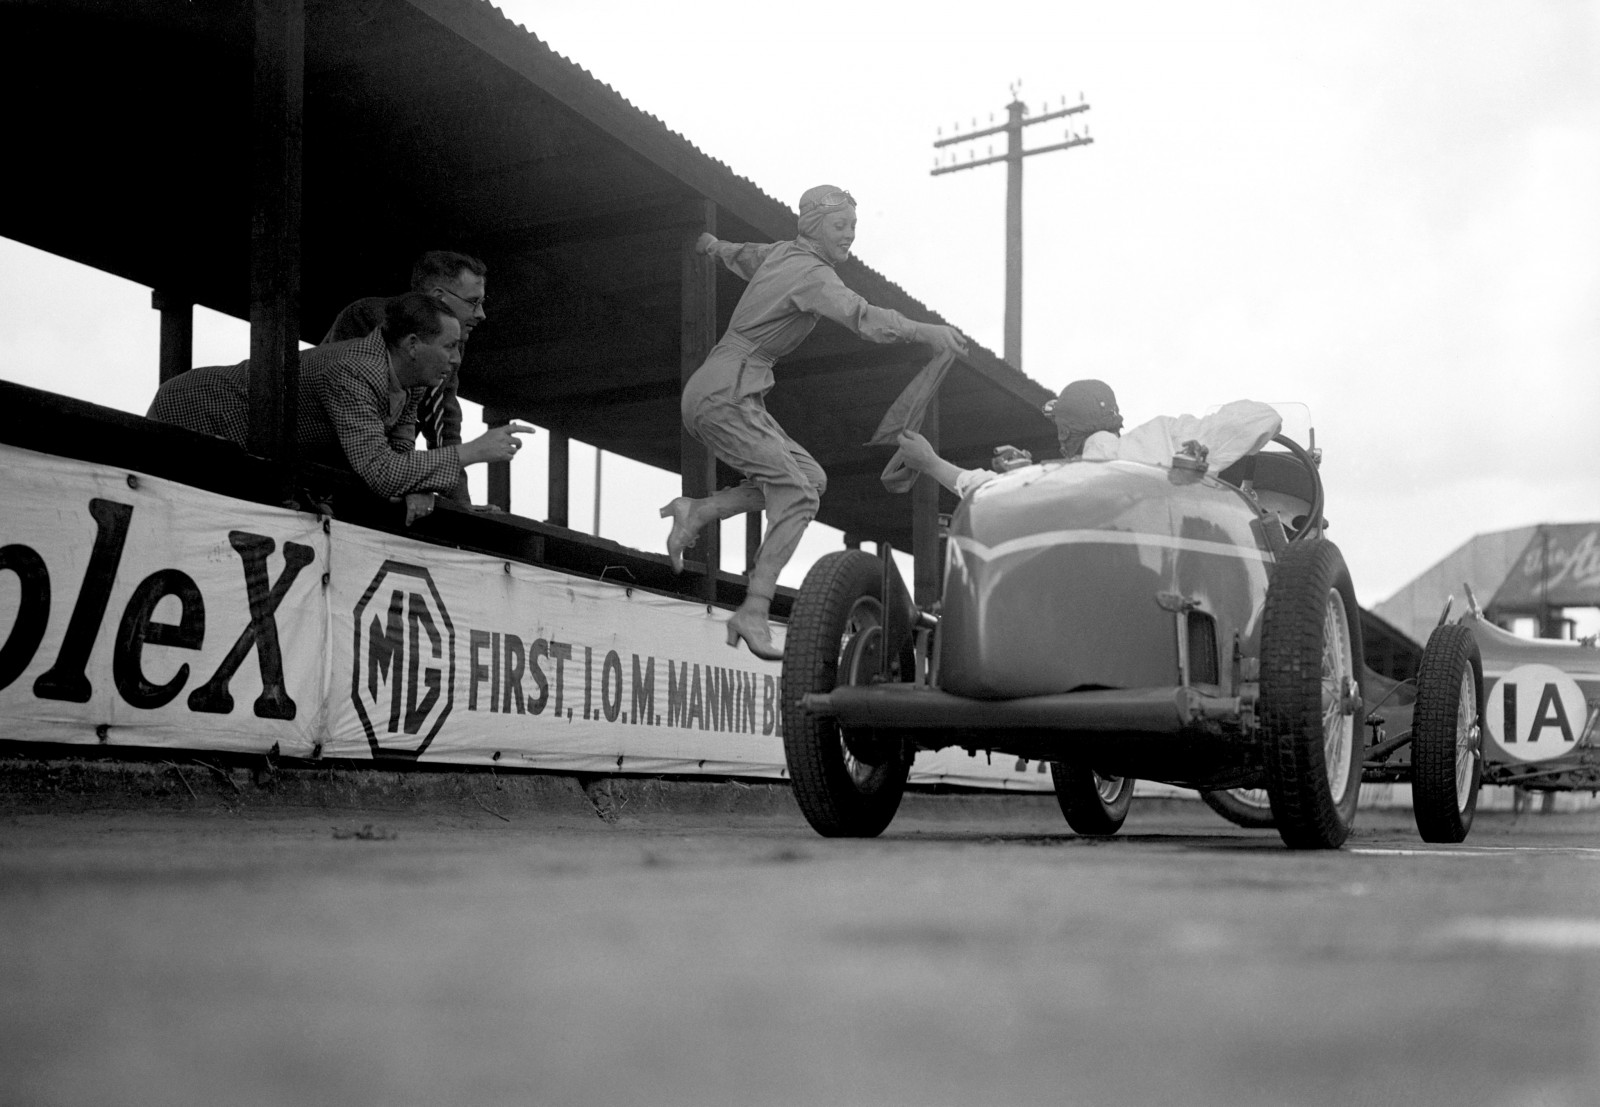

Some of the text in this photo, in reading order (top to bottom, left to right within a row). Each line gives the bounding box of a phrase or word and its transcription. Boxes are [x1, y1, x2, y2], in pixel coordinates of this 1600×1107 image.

[367, 589, 442, 735] MG
[468, 629, 573, 724] FIRST,
[583, 646, 661, 727] I.O.M.
[667, 659, 757, 735] MANNIN
